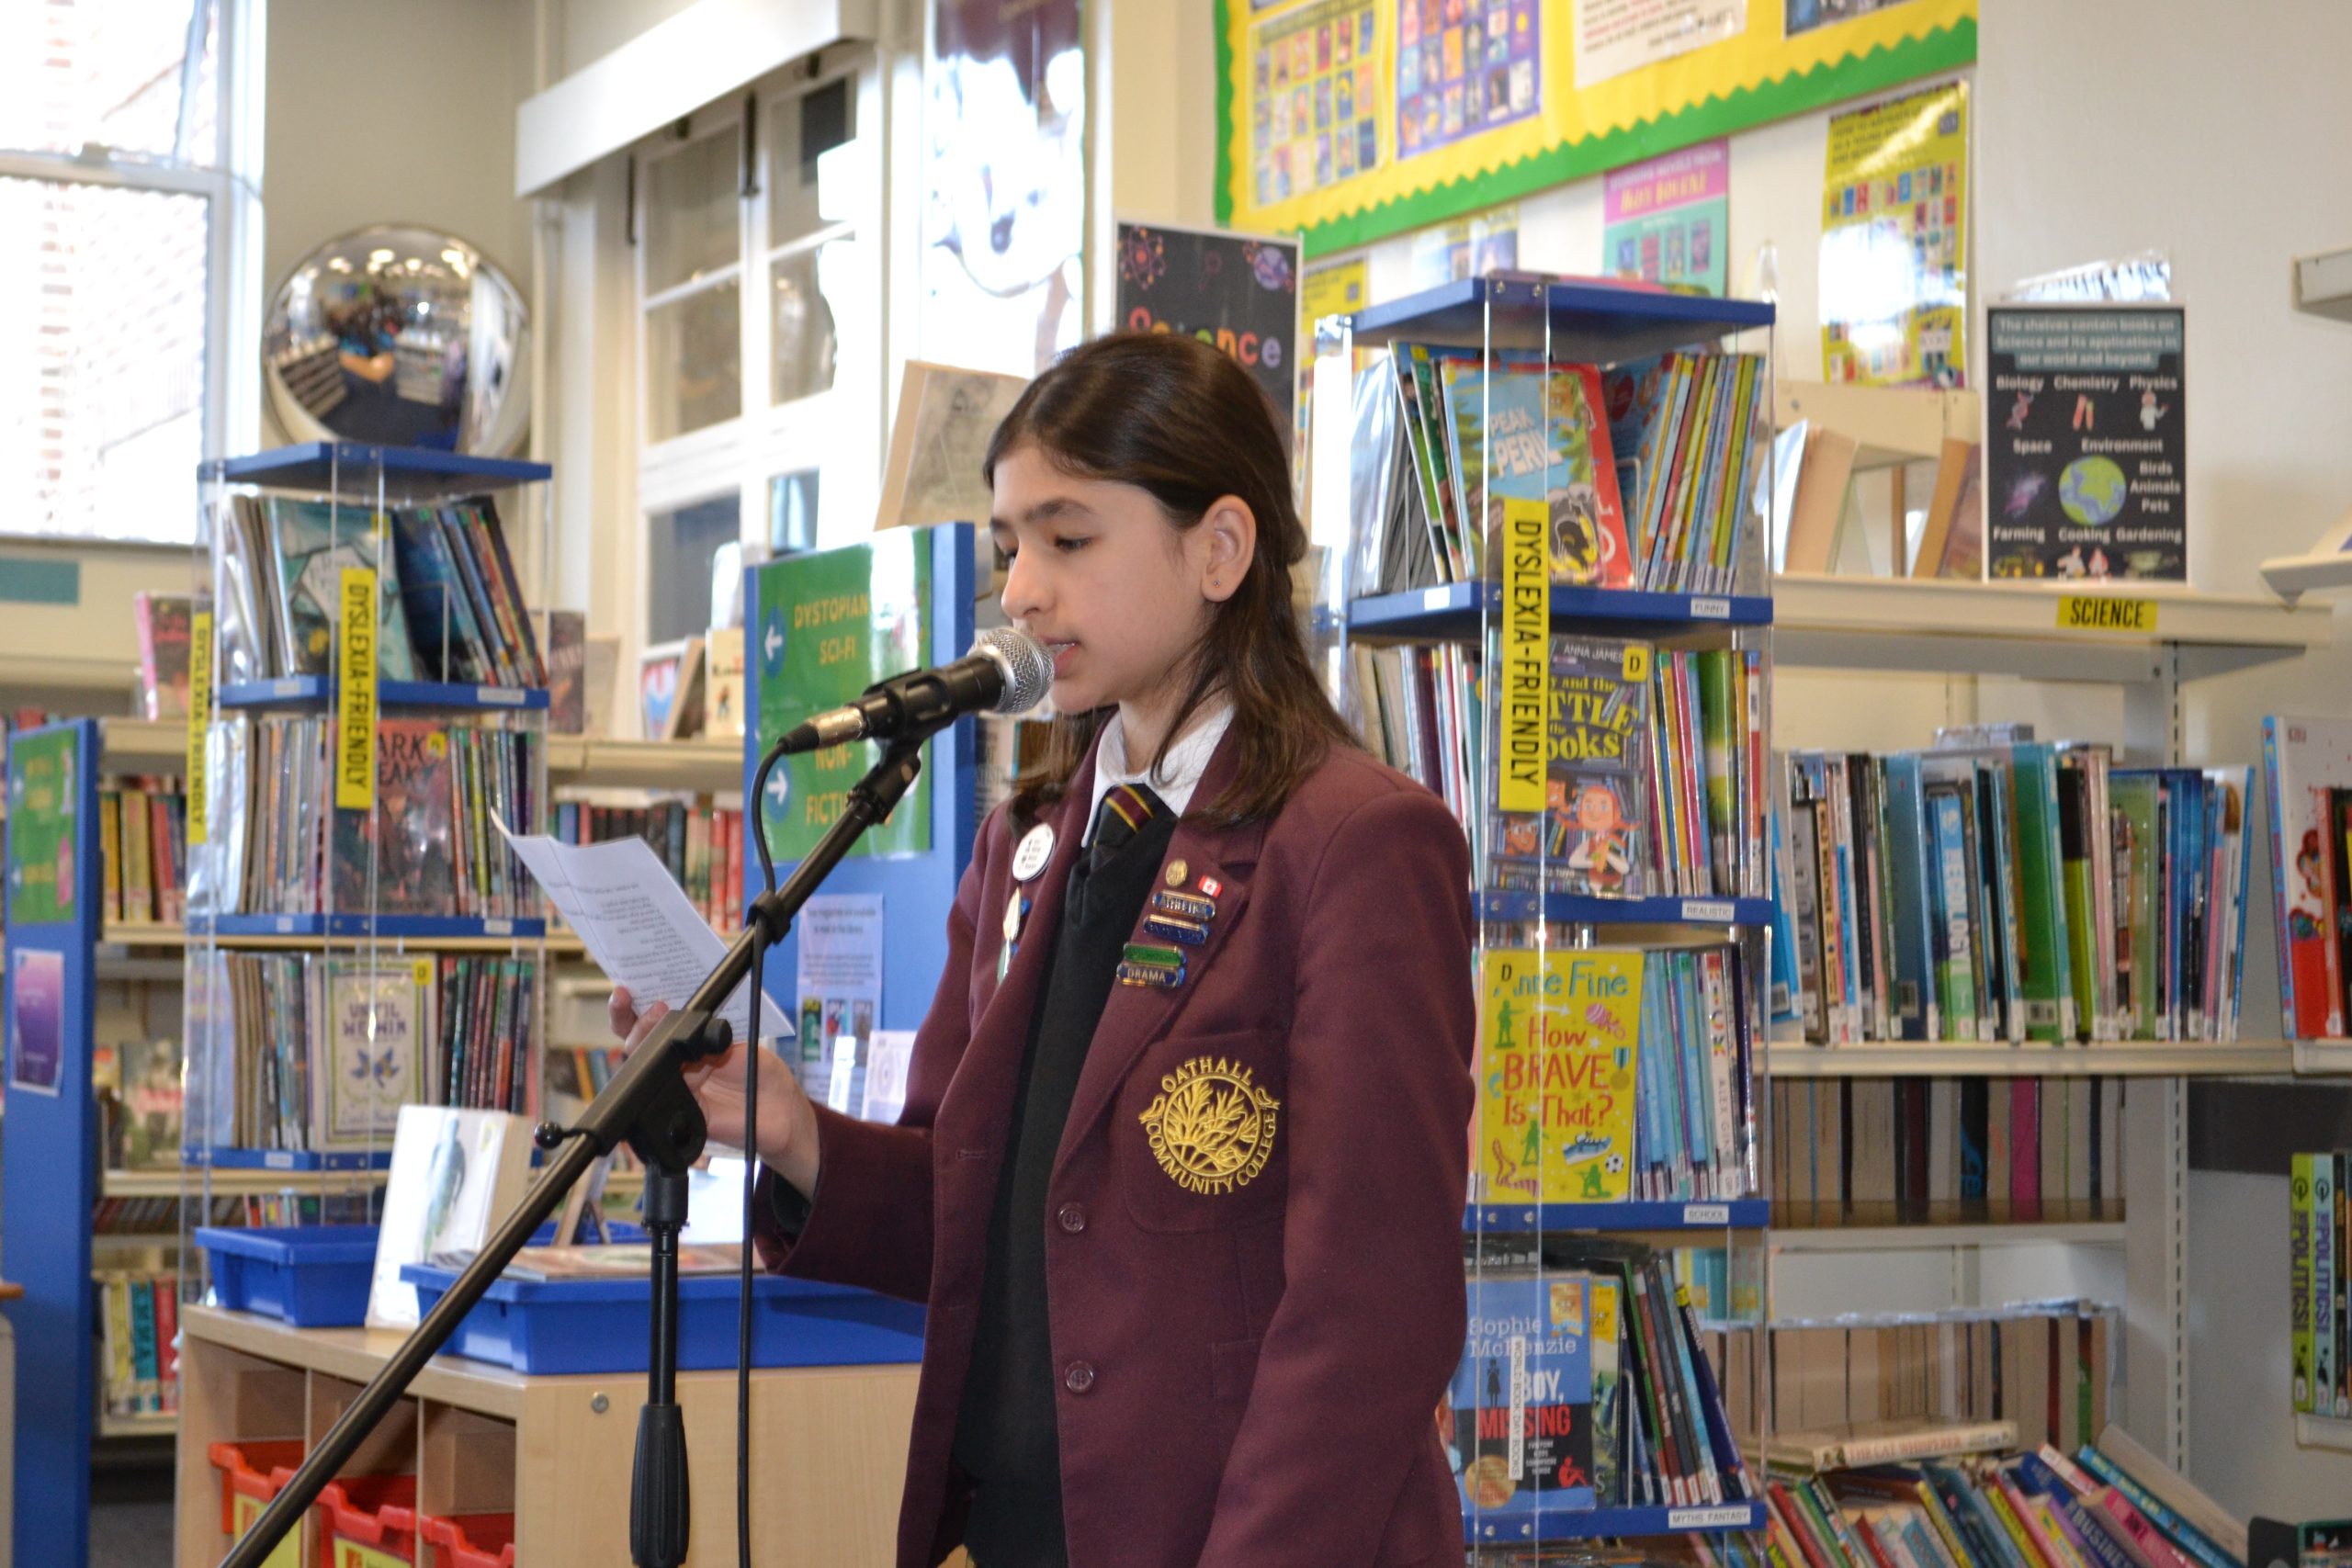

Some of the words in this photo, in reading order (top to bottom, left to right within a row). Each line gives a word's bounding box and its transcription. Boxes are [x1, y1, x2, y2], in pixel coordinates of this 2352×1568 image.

[1129, 306, 1282, 367] Snce
[2000, 318, 2022, 331] The
[2024, 318, 2067, 331] shelves
[2072, 318, 2118, 331] contain
[2120, 319, 2155, 331] books
[2159, 322, 2175, 331] on
[1996, 336, 2043, 348] Science
[2047, 336, 2068, 348] and
[2090, 336, 2162, 352] applications
[2165, 337, 2177, 348] in
[2019, 355, 2040, 366] our
[2043, 354, 2077, 366] world
[2080, 354, 2102, 366] and
[1996, 375, 2044, 393] Biology
[2053, 375, 2120, 394] Chemistry
[2129, 375, 2177, 392] Physics
[1489, 407, 1535, 436] PEAK
[1495, 430, 1564, 479] PERIL
[2013, 438, 2052, 455] Space
[2081, 437, 2164, 453] Environment
[2140, 461, 2173, 476] Birds
[2130, 479, 2181, 494] Animals
[2142, 498, 2170, 513] Pets
[1993, 525, 2046, 543] Farming
[2058, 527, 2110, 545] Cooking
[2116, 527, 2182, 545] Gardening
[794, 593, 868, 629] DYSTOPIAN
[1694, 603, 1724, 614] FUNNY
[2070, 597, 2143, 629] SCIENCE
[820, 636, 856, 664] SCI-FI
[1510, 520, 1542, 787] DYSLEXIA-FRIENDLY
[1564, 645, 1589, 660] ANNA
[1592, 647, 1623, 662] JAMES
[1629, 656, 1640, 673] D
[346, 584, 370, 788] DYSLEXIA-FRIENDLY
[1562, 676, 1589, 691] and
[1593, 675, 1617, 691] the
[1548, 689, 1638, 737] TTLE
[378, 732, 427, 761] ARK
[1546, 726, 1620, 761] ooks
[1686, 906, 1730, 918] REALISTIC
[1126, 967, 1166, 983] DRAMA
[1493, 974, 1562, 998] nne
[1568, 960, 1629, 998] Fine
[1500, 964, 1512, 982] D
[1528, 1014, 1588, 1049] How
[1160, 1056, 1253, 1093] OATHALL
[1503, 1053, 1611, 1091] BRAVE
[1717, 1079, 1729, 1112] ALEX
[1503, 1094, 1527, 1127] Is
[1542, 1093, 1614, 1128] That?
[1146, 1122, 1235, 1195] COMMUNITY
[1236, 1112, 1276, 1186] COLLEGE
[1688, 1210, 1725, 1220] SCHOOL
[1469, 1316, 1544, 1337] Sophie
[1515, 1341, 1523, 1379] WORLD
[1514, 1383, 1522, 1412] BOOK
[1523, 1368, 1565, 1404] BOY,
[1513, 1416, 1521, 1437] DAY
[1511, 1439, 1521, 1477] BOOKS
[1672, 1513, 1703, 1525] MYTHS
[1707, 1510, 1748, 1523] FANTASY
[2072, 1507, 2133, 1568] BUSINE
